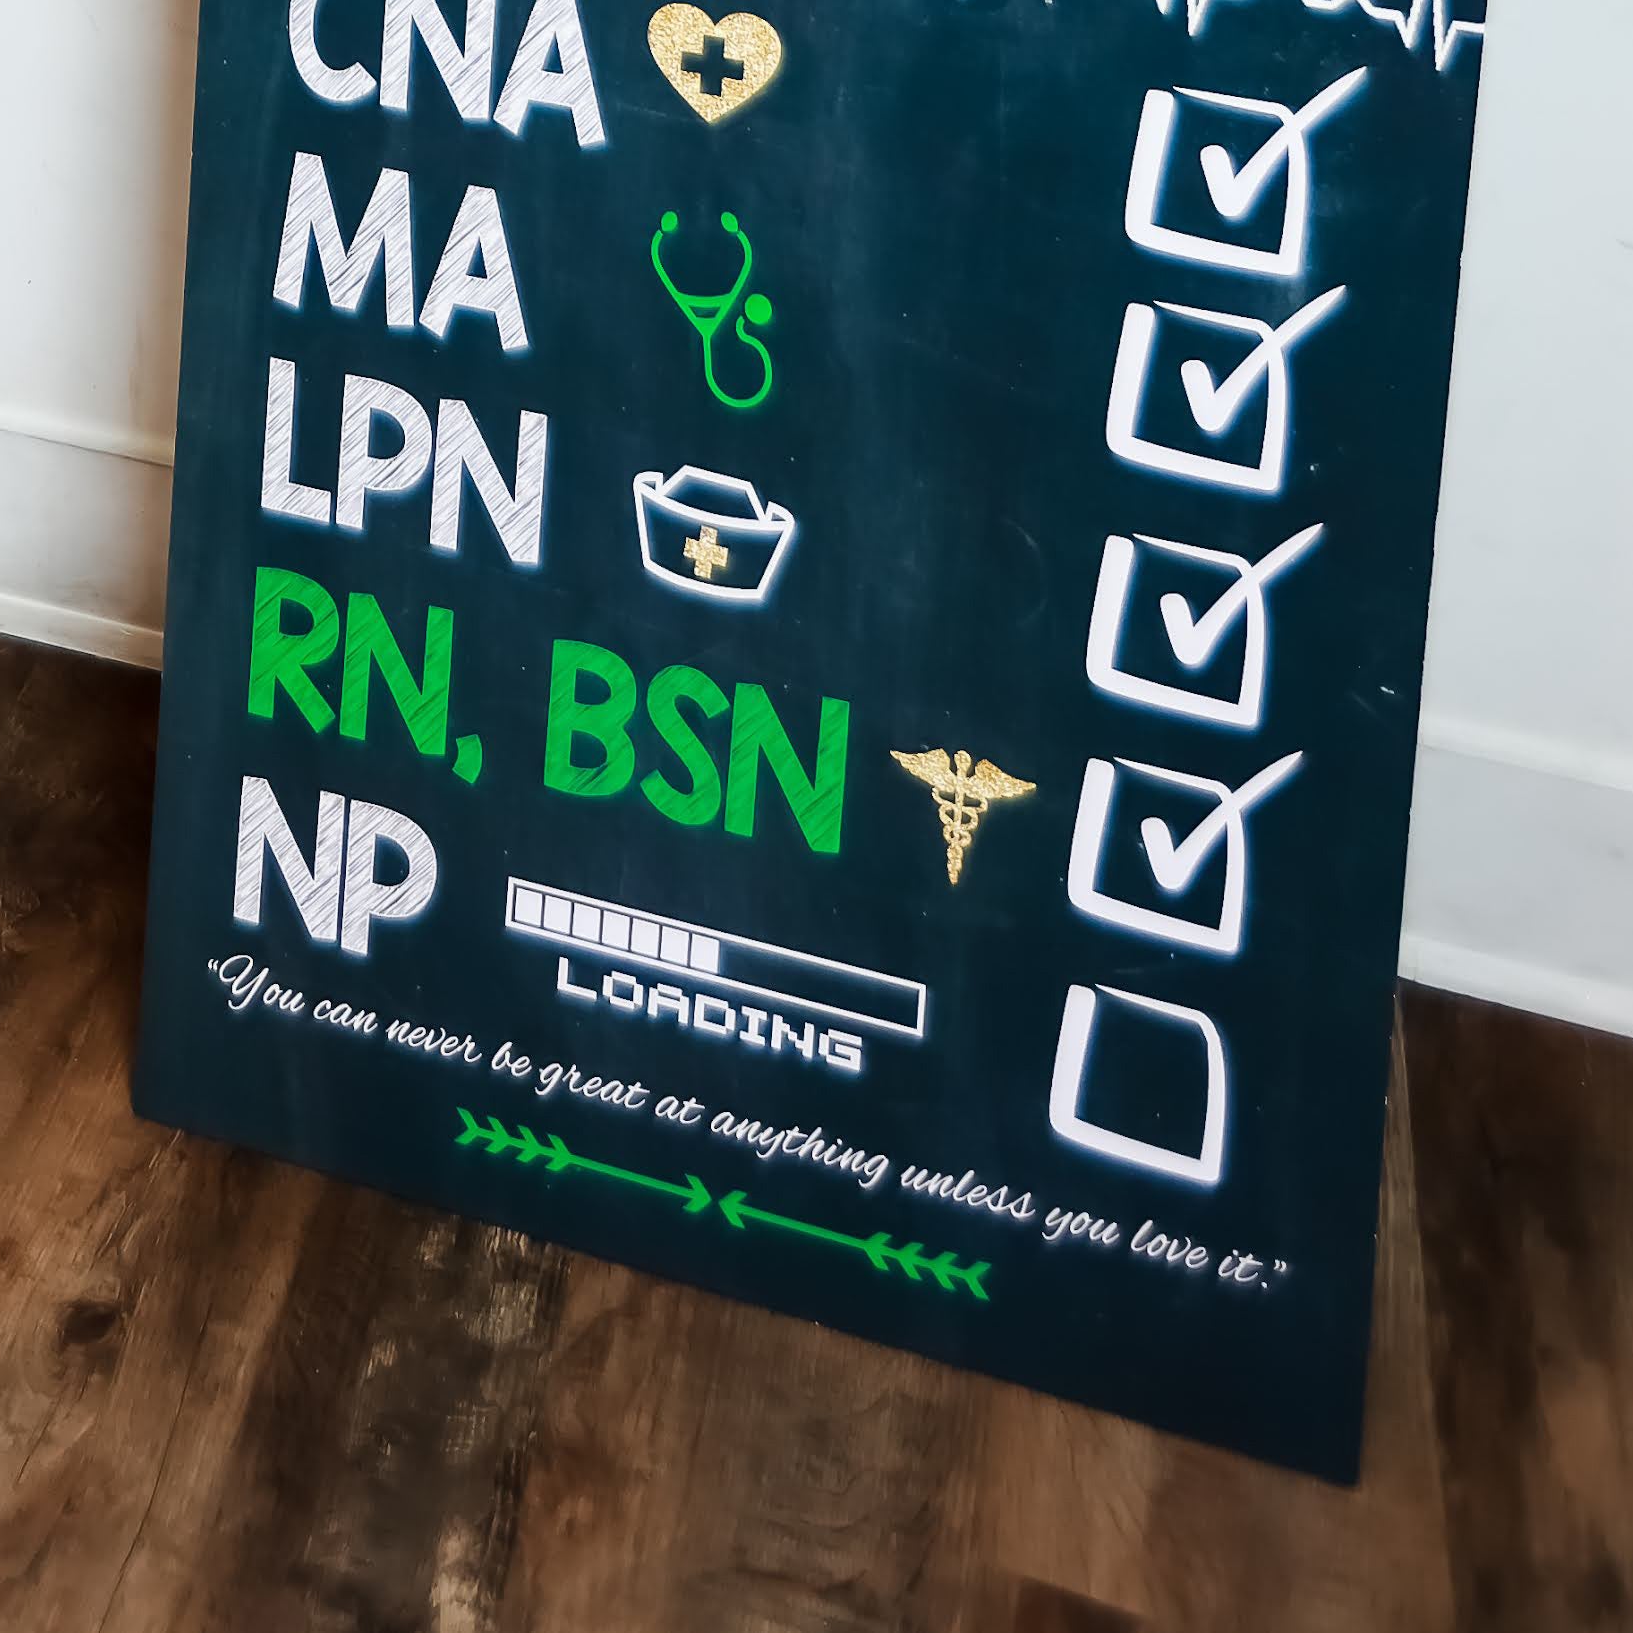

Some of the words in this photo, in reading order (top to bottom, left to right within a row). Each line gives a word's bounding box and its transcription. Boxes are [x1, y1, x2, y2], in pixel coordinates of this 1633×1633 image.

[270, 151, 533, 356] MA
[259, 354, 550, 569] LPN
[246, 566, 486, 783] RN,
[541, 636, 852, 857] BSN
[232, 774, 440, 956] NP
[557, 956, 863, 1073] LOADING
[313, 1000, 377, 1034] can
[386, 1020, 483, 1064] never
[490, 1041, 533, 1077] be
[536, 1060, 650, 1110] great
[654, 1090, 706, 1125] at
[709, 1107, 890, 1187] anything
[900, 1164, 1036, 1221] unless
[1041, 1197, 1120, 1241] you
[1130, 1219, 1209, 1271] love
